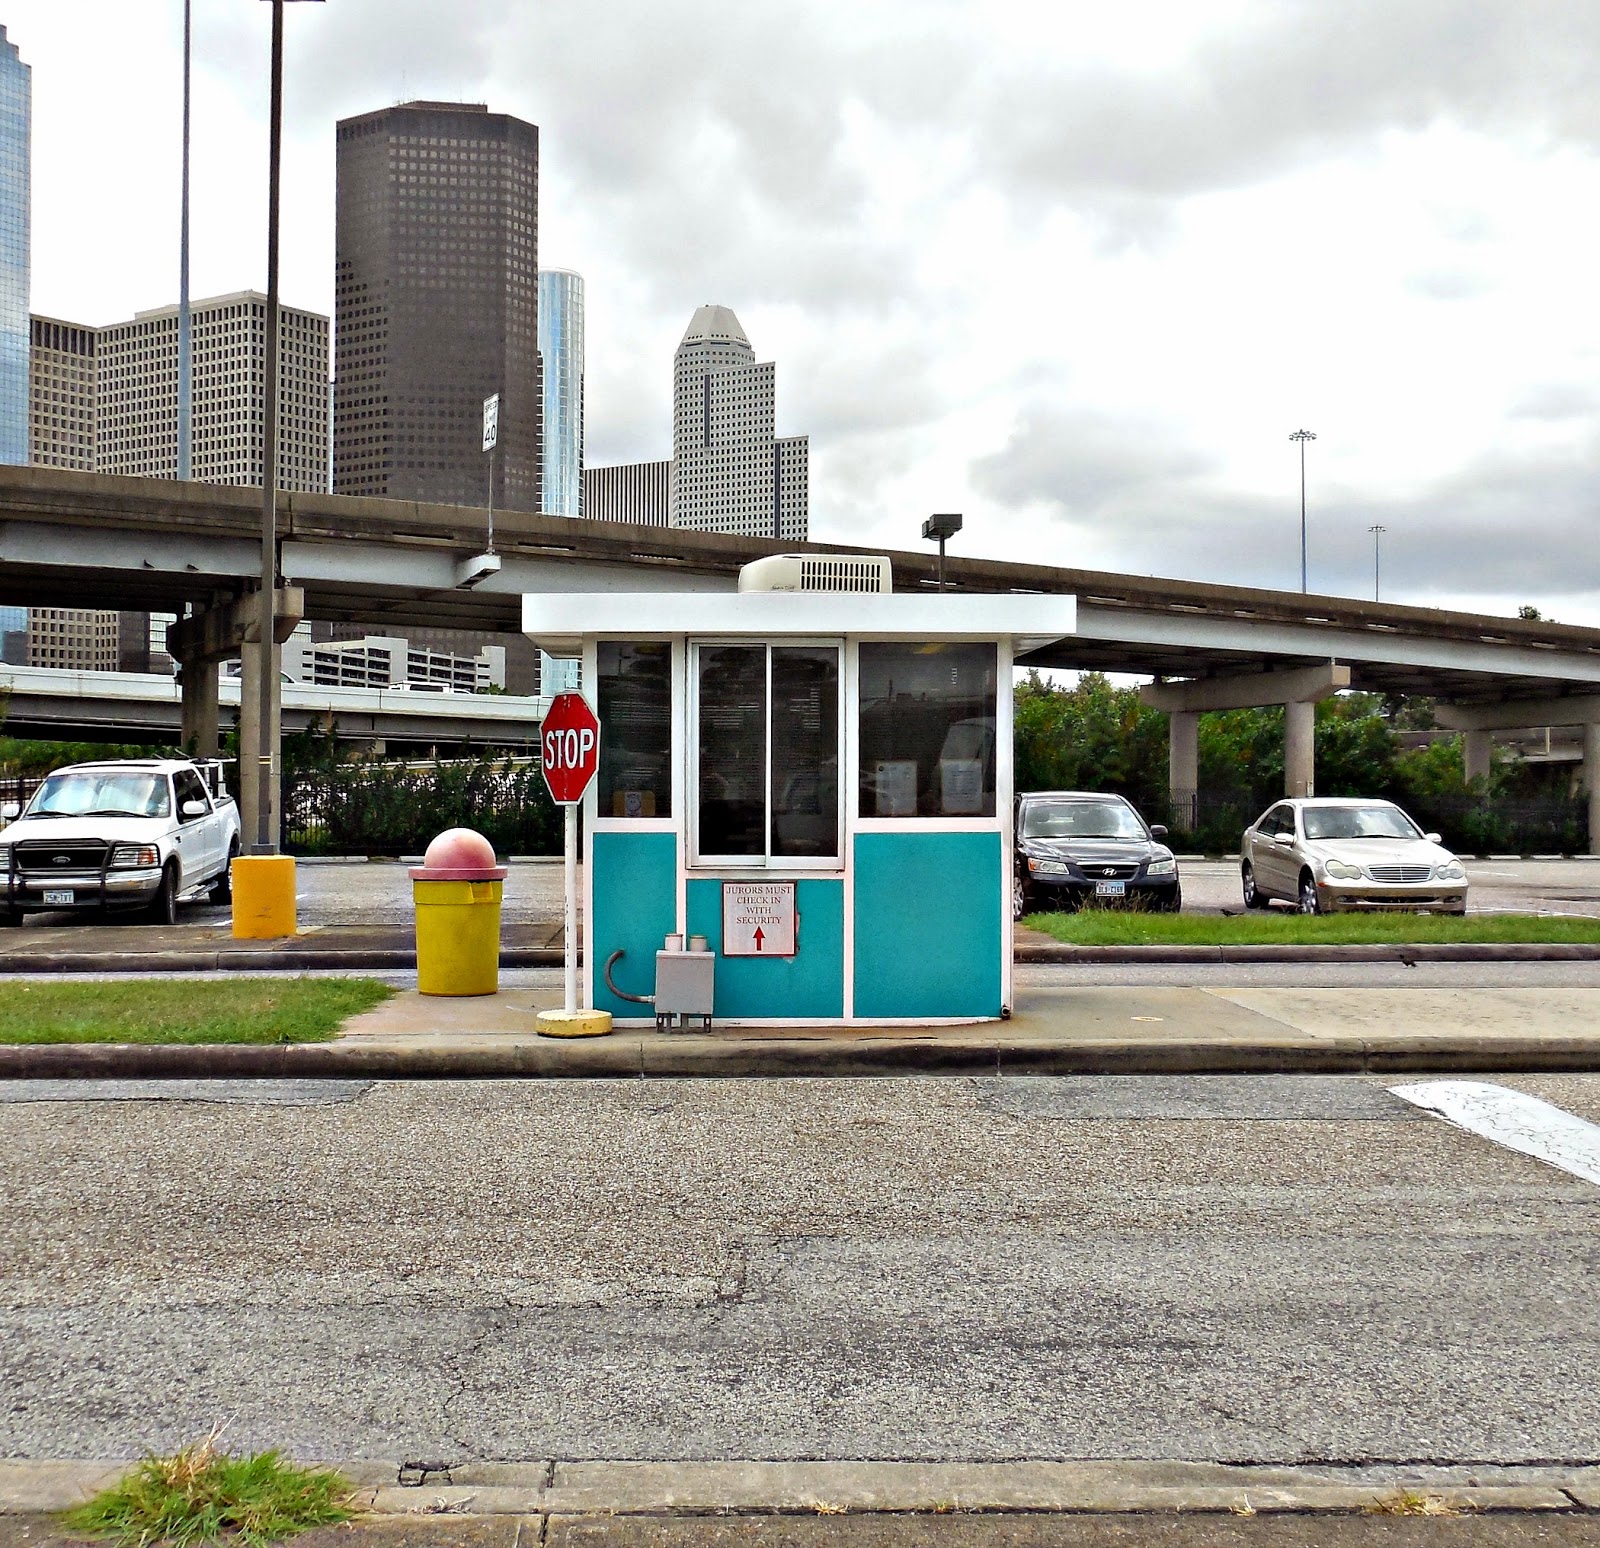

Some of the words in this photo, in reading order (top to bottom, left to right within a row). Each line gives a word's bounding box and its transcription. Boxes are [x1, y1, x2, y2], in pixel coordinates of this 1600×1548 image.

[485, 424, 496, 441] 40
[545, 728, 594, 770] STOP
[726, 886, 763, 894] JURORS
[765, 886, 792, 894] MUST
[736, 896, 768, 904] CHECK
[771, 896, 781, 904] IN
[746, 906, 771, 914] WITH
[736, 916, 782, 924] SECURITY
